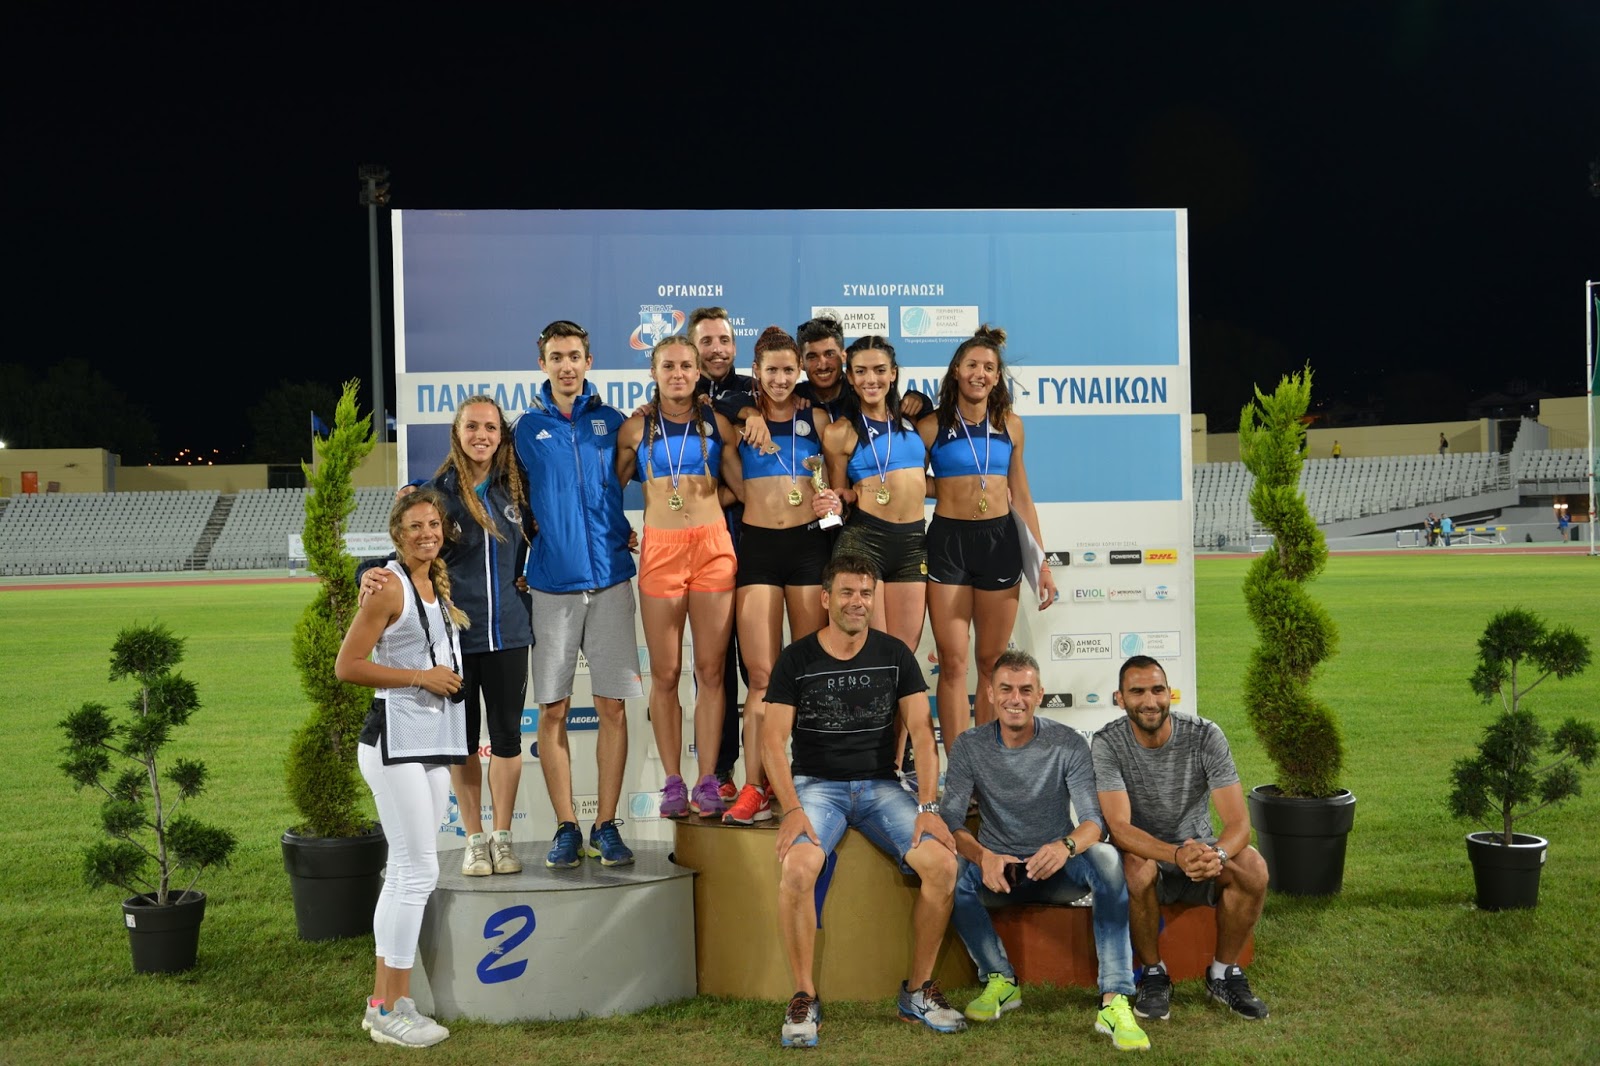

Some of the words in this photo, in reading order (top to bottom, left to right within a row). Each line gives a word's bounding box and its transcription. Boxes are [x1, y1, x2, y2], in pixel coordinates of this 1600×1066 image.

[657, 284, 723, 297] ΟΡΓΑΝΩΣΗ
[843, 284, 945, 296] ΣΥΝΔΙΟΡΓΑΝΩΣΗ
[640, 304, 674, 312] ΣΕΓΑΣ
[844, 313, 876, 321] ΔΗΜΟΣ
[844, 322, 887, 330] ΠΑΤΡΕΩΝ
[1038, 377, 1167, 404] ΓΥΝΑΙΚΩΝ
[1076, 588, 1105, 598] EVIOL
[1076, 646, 1110, 654] ΠΑΤΡΕΩΝ
[827, 674, 871, 689] RENO
[476, 904, 536, 985] 2
